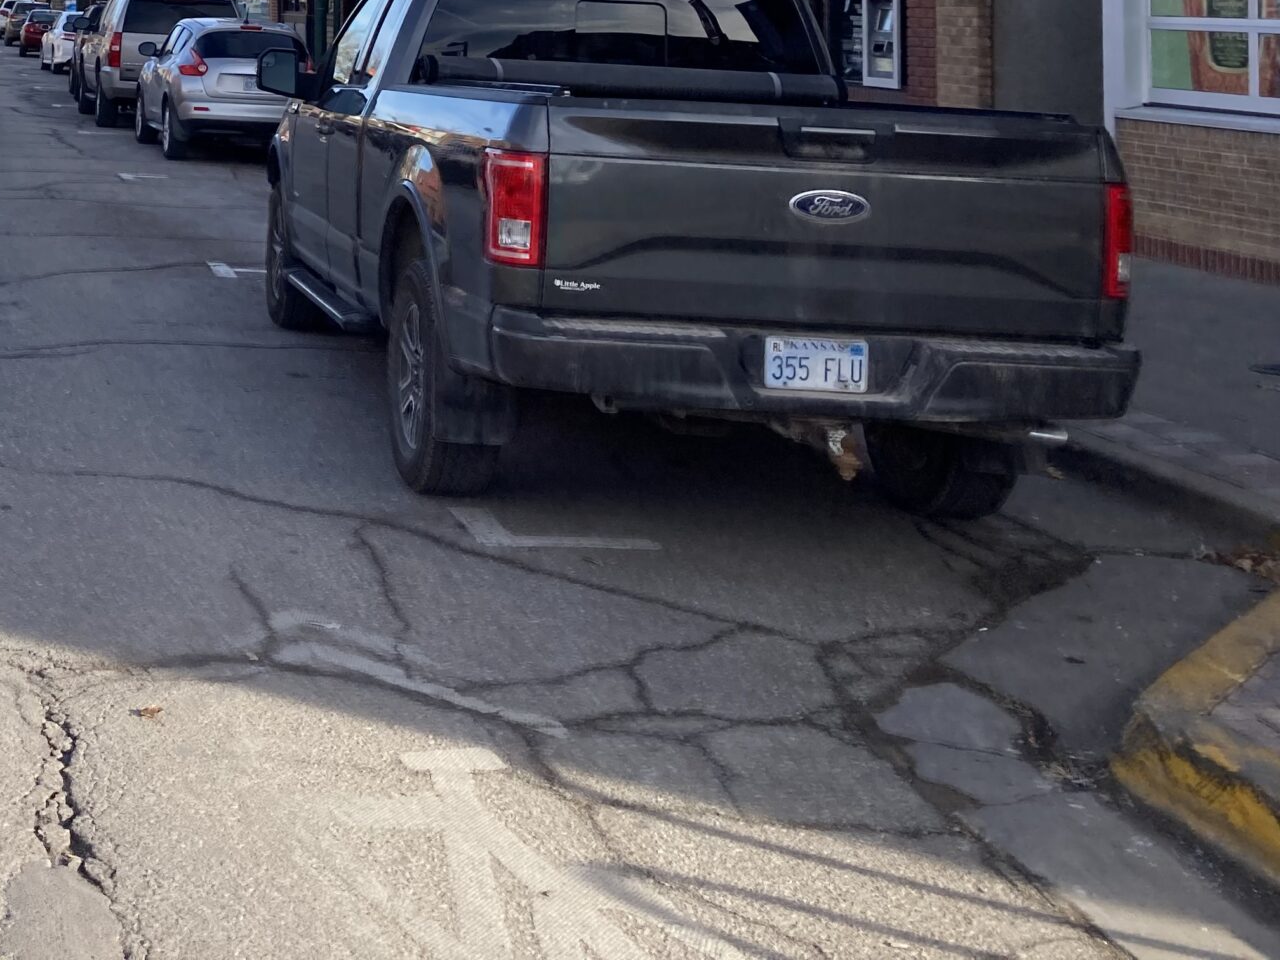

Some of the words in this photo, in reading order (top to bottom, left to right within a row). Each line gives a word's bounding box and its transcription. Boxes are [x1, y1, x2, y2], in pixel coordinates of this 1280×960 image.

[809, 196, 854, 216] Ford
[580, 282, 600, 290] Apple
[790, 340, 846, 352] KANSAS
[772, 355, 810, 381] 355
[824, 358, 863, 383] FLU
